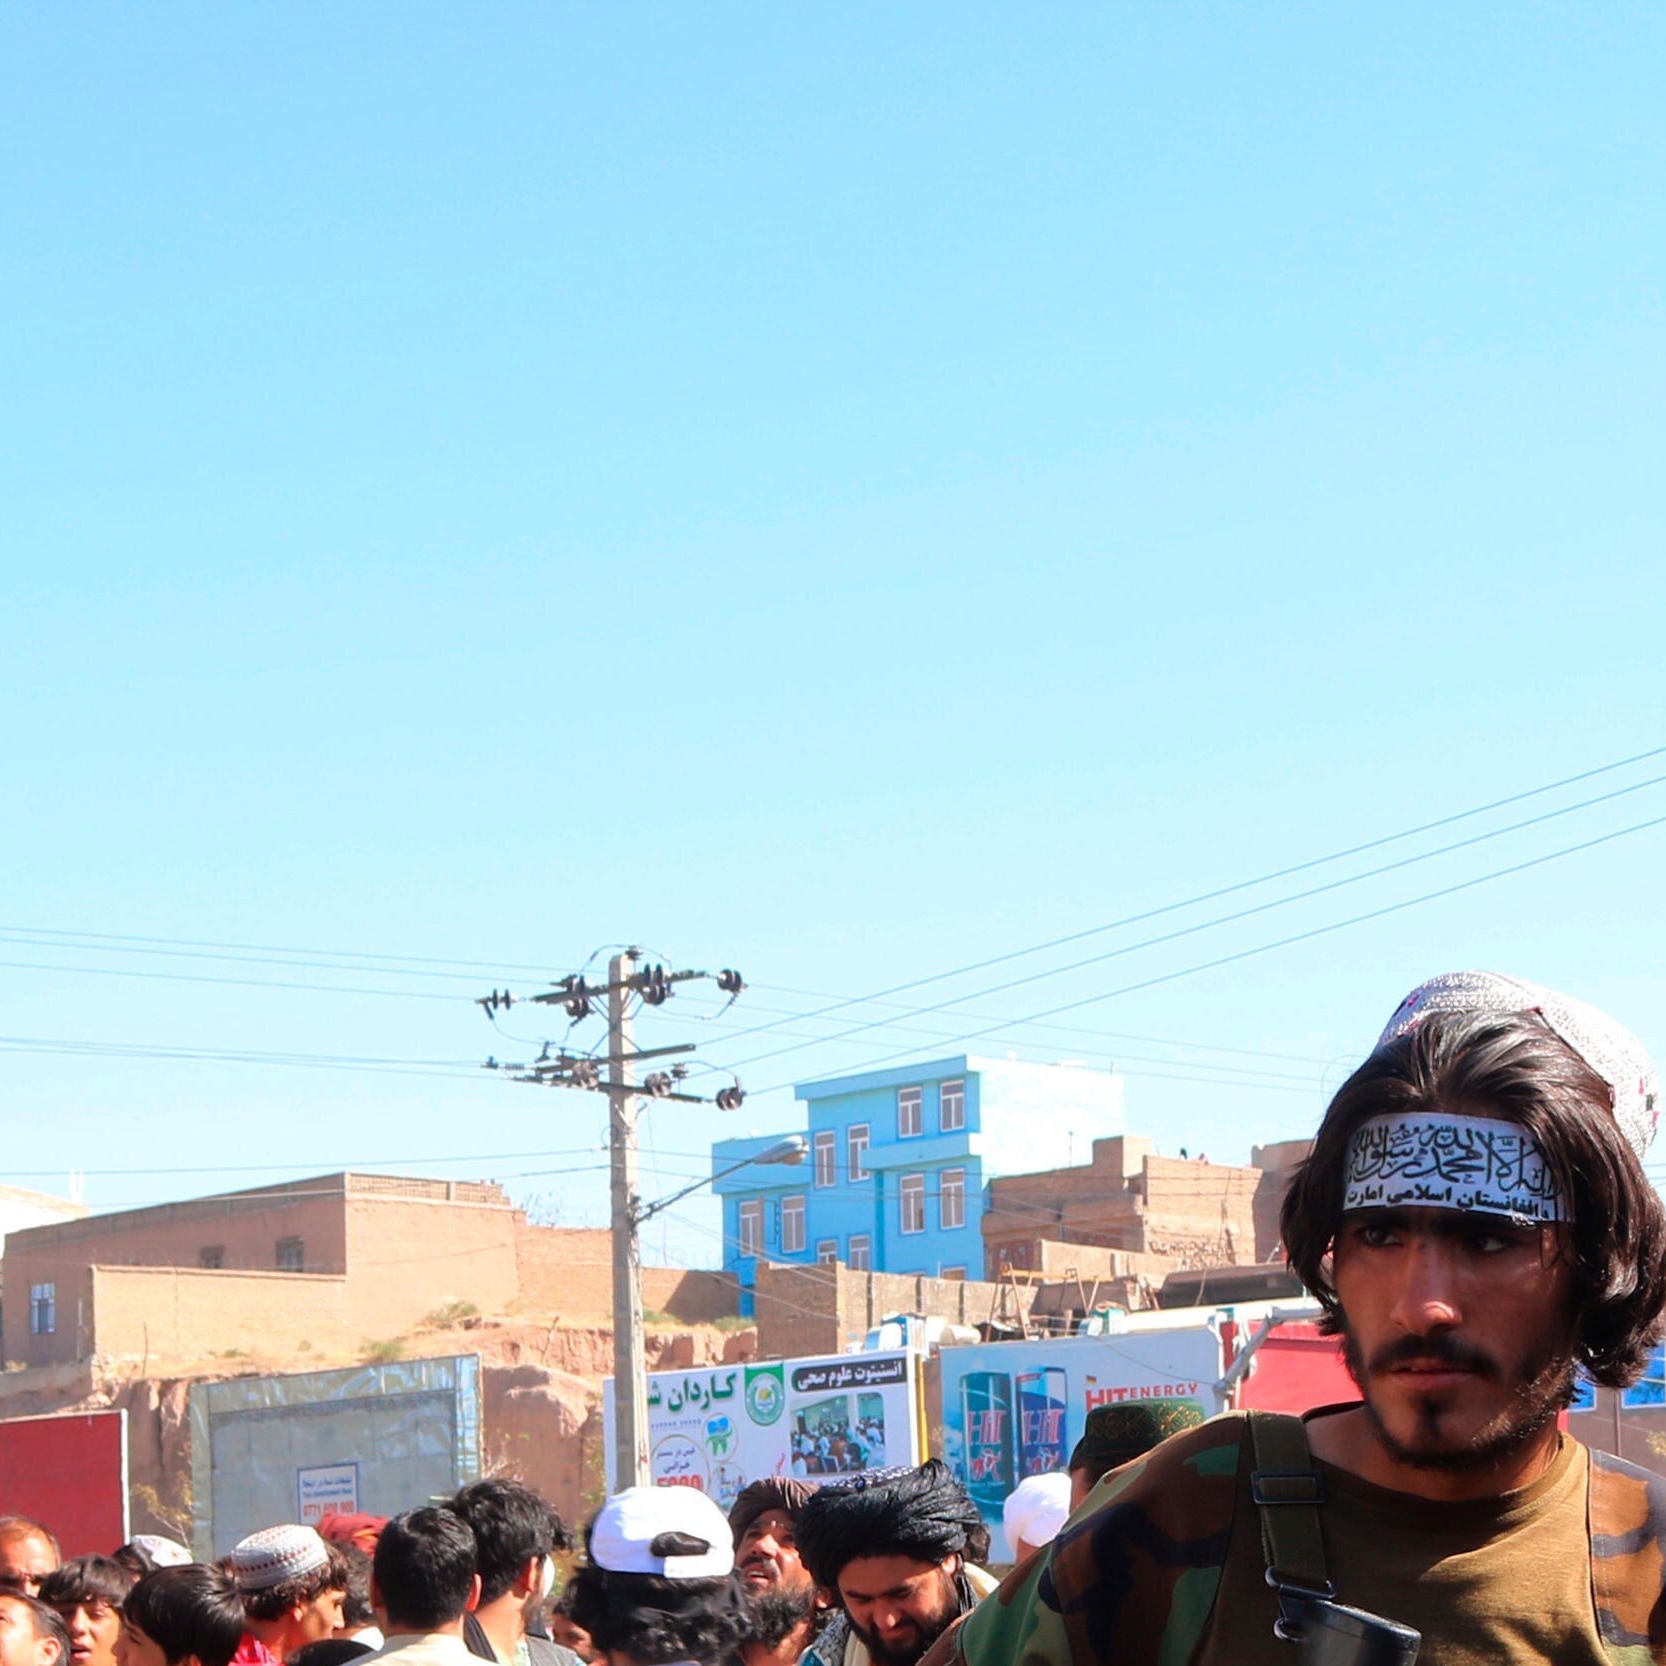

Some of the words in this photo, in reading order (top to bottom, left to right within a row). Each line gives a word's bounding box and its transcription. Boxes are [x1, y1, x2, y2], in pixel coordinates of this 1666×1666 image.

[828, 1365, 853, 1387] علوم
[667, 1372, 737, 1412] کاردان
[1129, 1382, 1197, 1398] ENERGY
